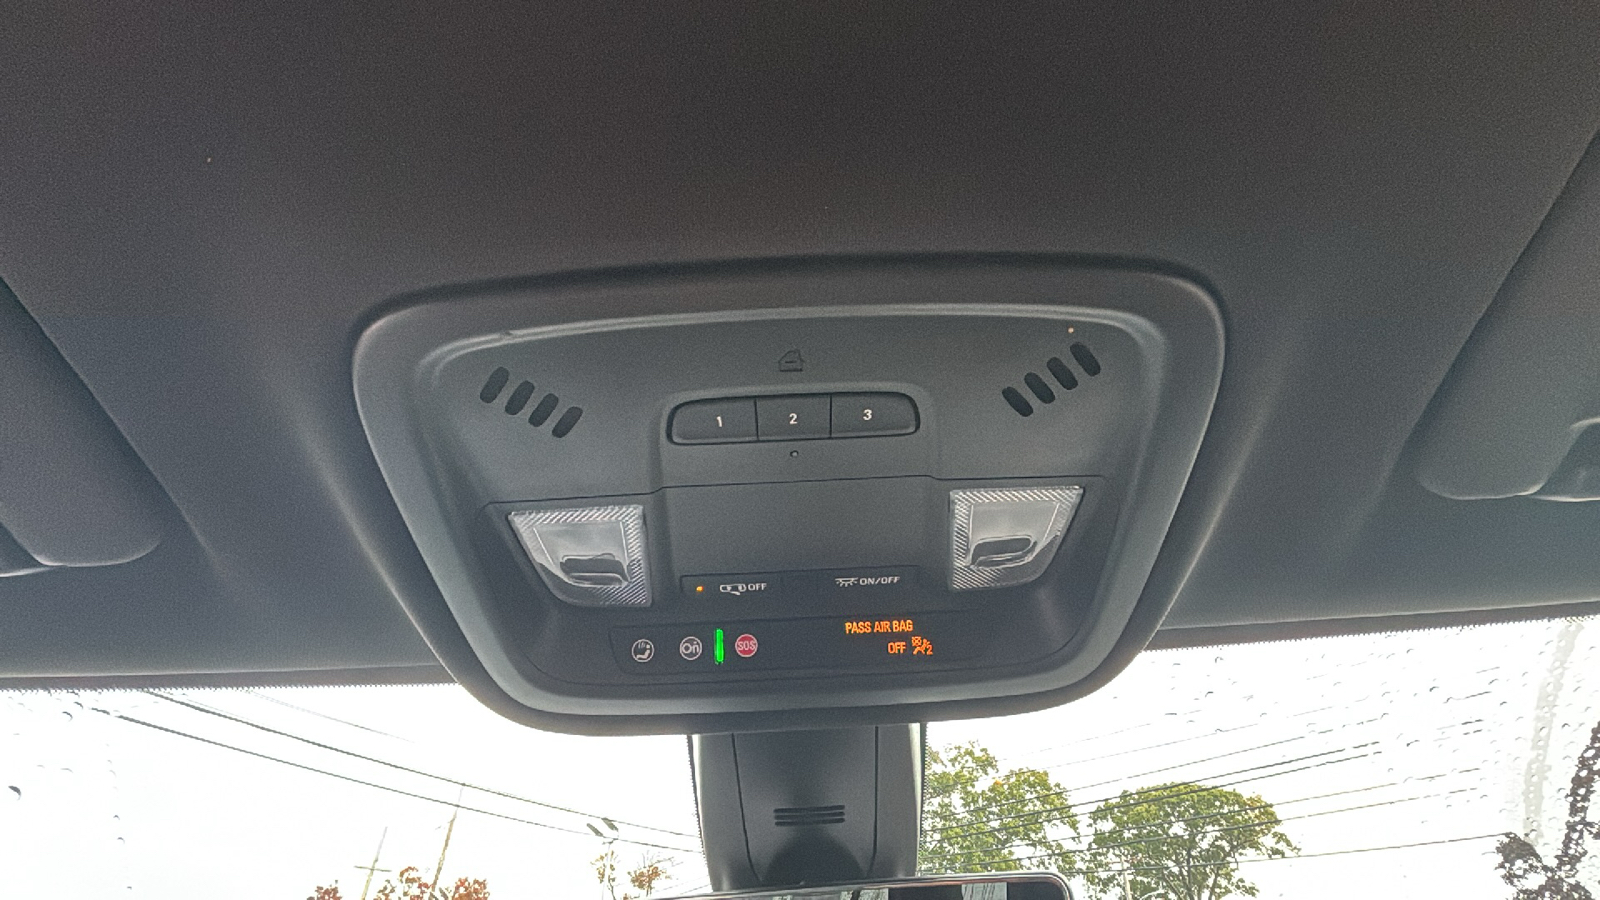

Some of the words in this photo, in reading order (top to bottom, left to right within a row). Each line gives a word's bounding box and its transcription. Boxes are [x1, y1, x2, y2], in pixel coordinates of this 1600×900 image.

[716, 415, 723, 427] 1
[788, 413, 798, 425] 2
[862, 409, 873, 421] 3
[859, 575, 901, 586] ON/OFF
[747, 582, 768, 592] OFF
[845, 621, 872, 634] PASS
[873, 620, 891, 633] AIR
[892, 619, 913, 632] BAG
[737, 640, 756, 651] SOS
[887, 642, 906, 654] OFF
